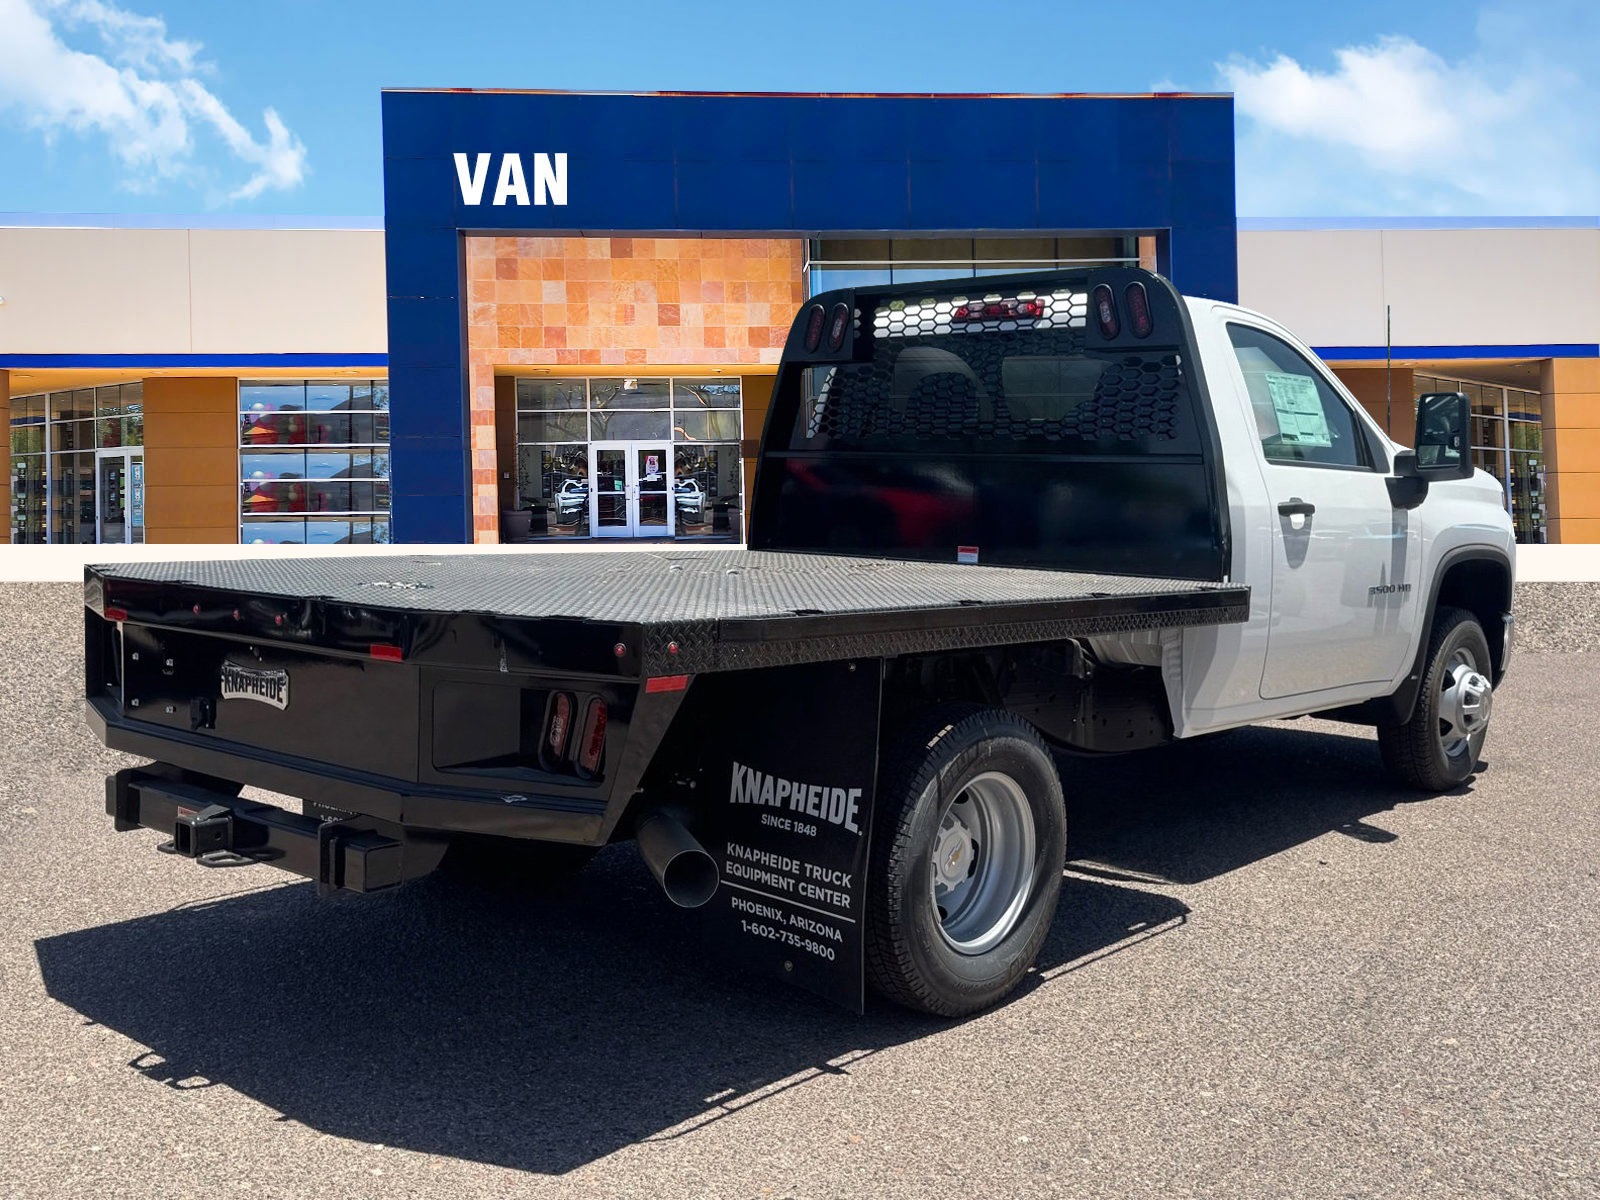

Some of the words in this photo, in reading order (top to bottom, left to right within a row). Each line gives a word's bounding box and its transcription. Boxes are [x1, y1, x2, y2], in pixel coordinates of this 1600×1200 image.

[452, 152, 568, 206] VAN
[1369, 585, 1396, 595] 3500
[1397, 583, 1412, 592] HD
[224, 666, 285, 704] KNAPHEIDE
[729, 761, 862, 835] KNAPHEIDE
[761, 814, 791, 830] SINCE
[793, 821, 817, 837] 1848
[725, 861, 795, 892] EQUIPMENT
[798, 882, 850, 908] CENTER
[727, 842, 800, 874] KNAPHEIDE
[804, 863, 852, 888] TRUCK
[731, 896, 787, 925] PHOENIX,
[789, 914, 843, 942] ARIZONA
[741, 919, 835, 961] 1-602-735-9800
